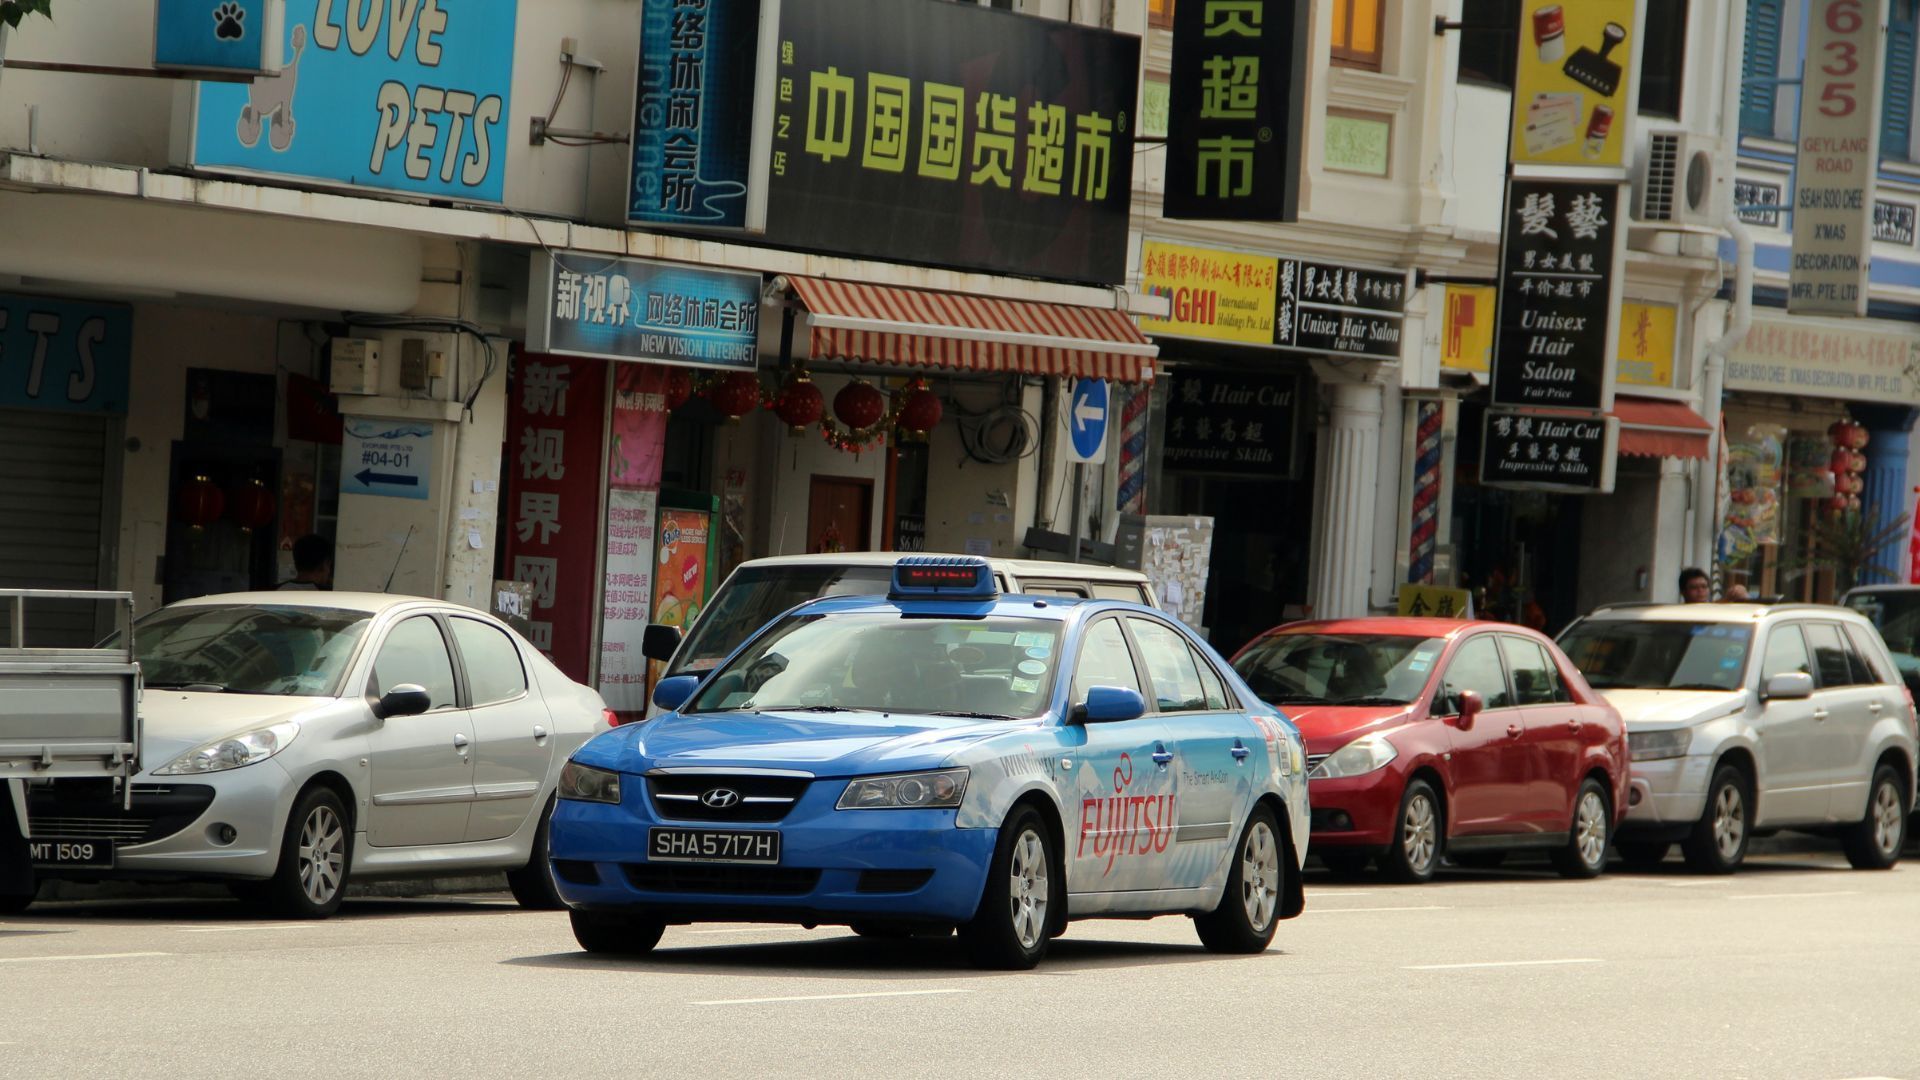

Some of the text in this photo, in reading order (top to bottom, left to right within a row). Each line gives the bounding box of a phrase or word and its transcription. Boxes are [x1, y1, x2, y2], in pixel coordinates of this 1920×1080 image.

[313, 0, 448, 67] LOVE
[369, 79, 502, 187] PETS
[634, 53, 672, 211] internet
[805, 66, 1112, 201] 中国国货超市
[1804, 137, 1867, 153] GEYLANG
[1815, 158, 1853, 173] ROAD
[1800, 188, 1821, 209] SEAH
[1814, 223, 1846, 240] X'MAS
[1795, 254, 1859, 271] DECORATION
[557, 270, 757, 334] 新视界 网络休闲会所
[1218, 294, 1259, 312] International
[1217, 312, 1245, 331] Holdings
[1301, 313, 1399, 342] Unisex Hair Salon
[1521, 310, 1586, 331] Unisex
[0, 308, 106, 402] TS
[641, 334, 756, 362] NEW VISION INTERNET
[1334, 338, 1365, 351] Fair Price
[1529, 336, 1574, 356] Hair
[1522, 361, 1576, 382] Salon
[1211, 384, 1254, 405] Hair
[1257, 384, 1291, 406] Cut
[1524, 386, 1572, 399] Fair Price
[1538, 421, 1572, 438] Hair
[1574, 423, 1601, 439] Cut
[362, 450, 409, 468] #04-01
[1163, 446, 1274, 463] mpressive Skills
[1499, 460, 1589, 474] Impressive Skills
[683, 563, 698, 584] NEW
[657, 833, 771, 857] SHA5717H
[1077, 794, 1175, 877] FUJITSU
[57, 844, 93, 860] 1509
